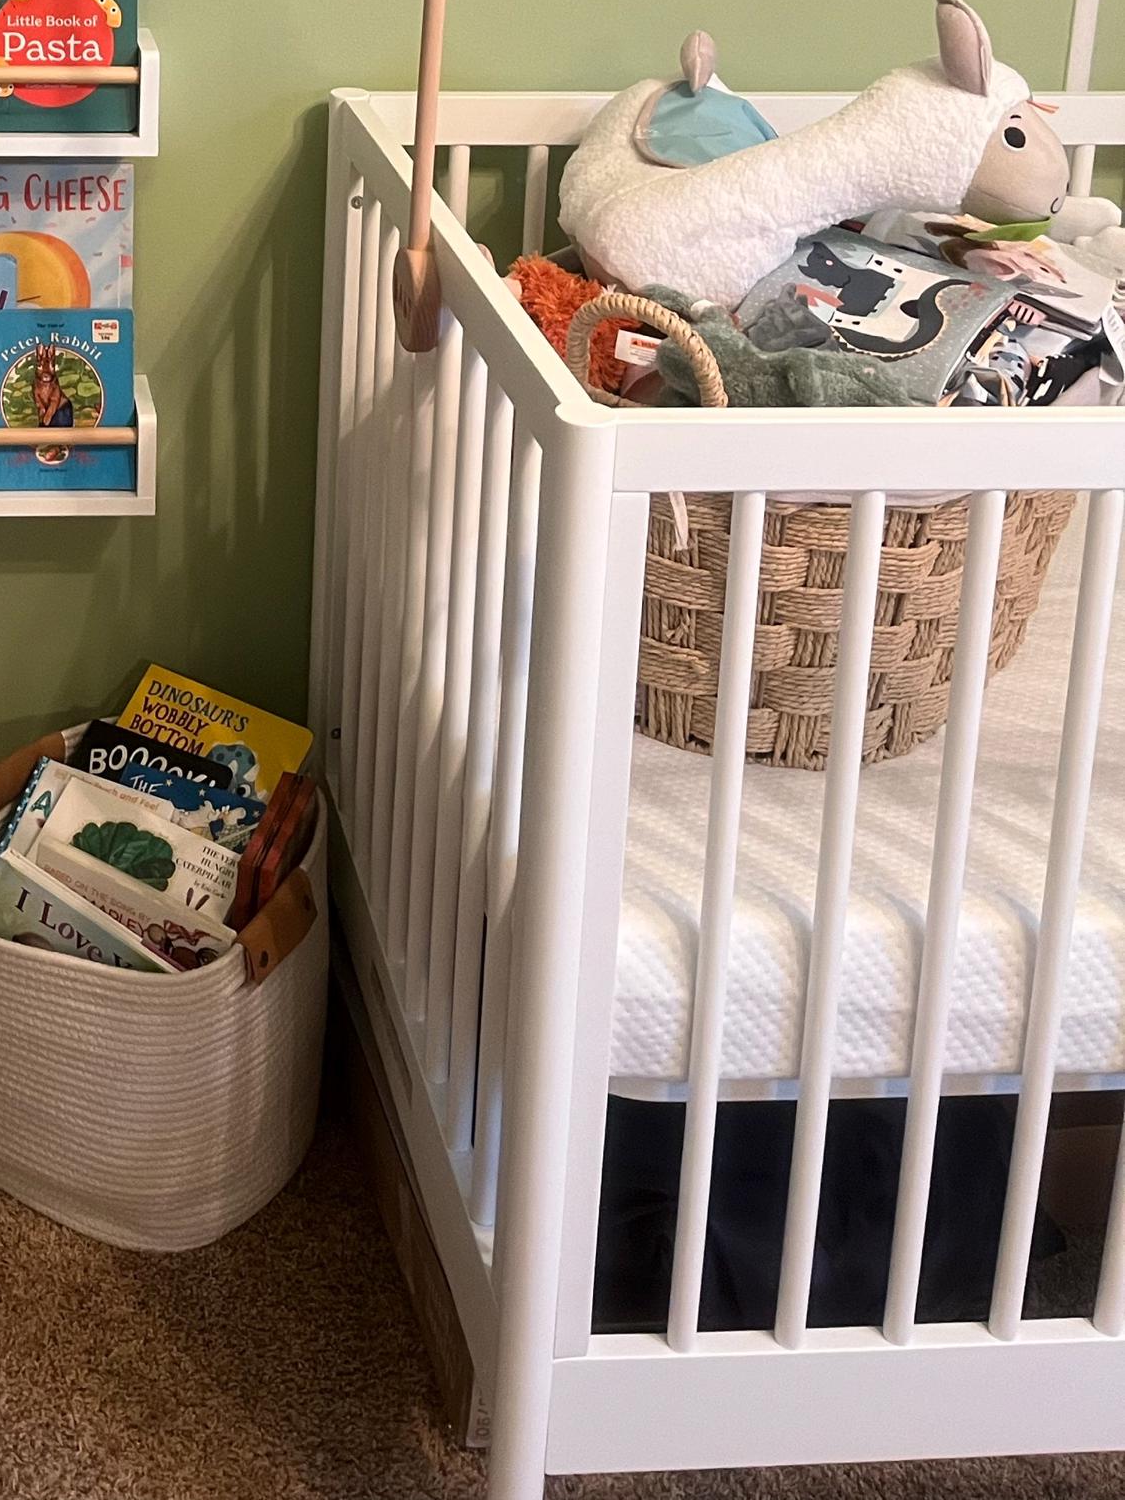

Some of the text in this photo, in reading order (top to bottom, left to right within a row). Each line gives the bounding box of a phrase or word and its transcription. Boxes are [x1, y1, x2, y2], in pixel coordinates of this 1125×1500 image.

[6, 14, 99, 27] Little Book of
[2, 31, 104, 62] Pasta
[23, 173, 127, 212] CHEESE
[0, 335, 40, 362] Peter
[50, 331, 103, 361] Rabbit
[142, 696, 210, 737] WOBBLY
[147, 679, 250, 733] DINOSAUR'S
[129, 713, 205, 756] BOTTOM
[200, 857, 235, 879] HUNGRY
[202, 846, 221, 859] THE
[15, 886, 103, 963] I Love
